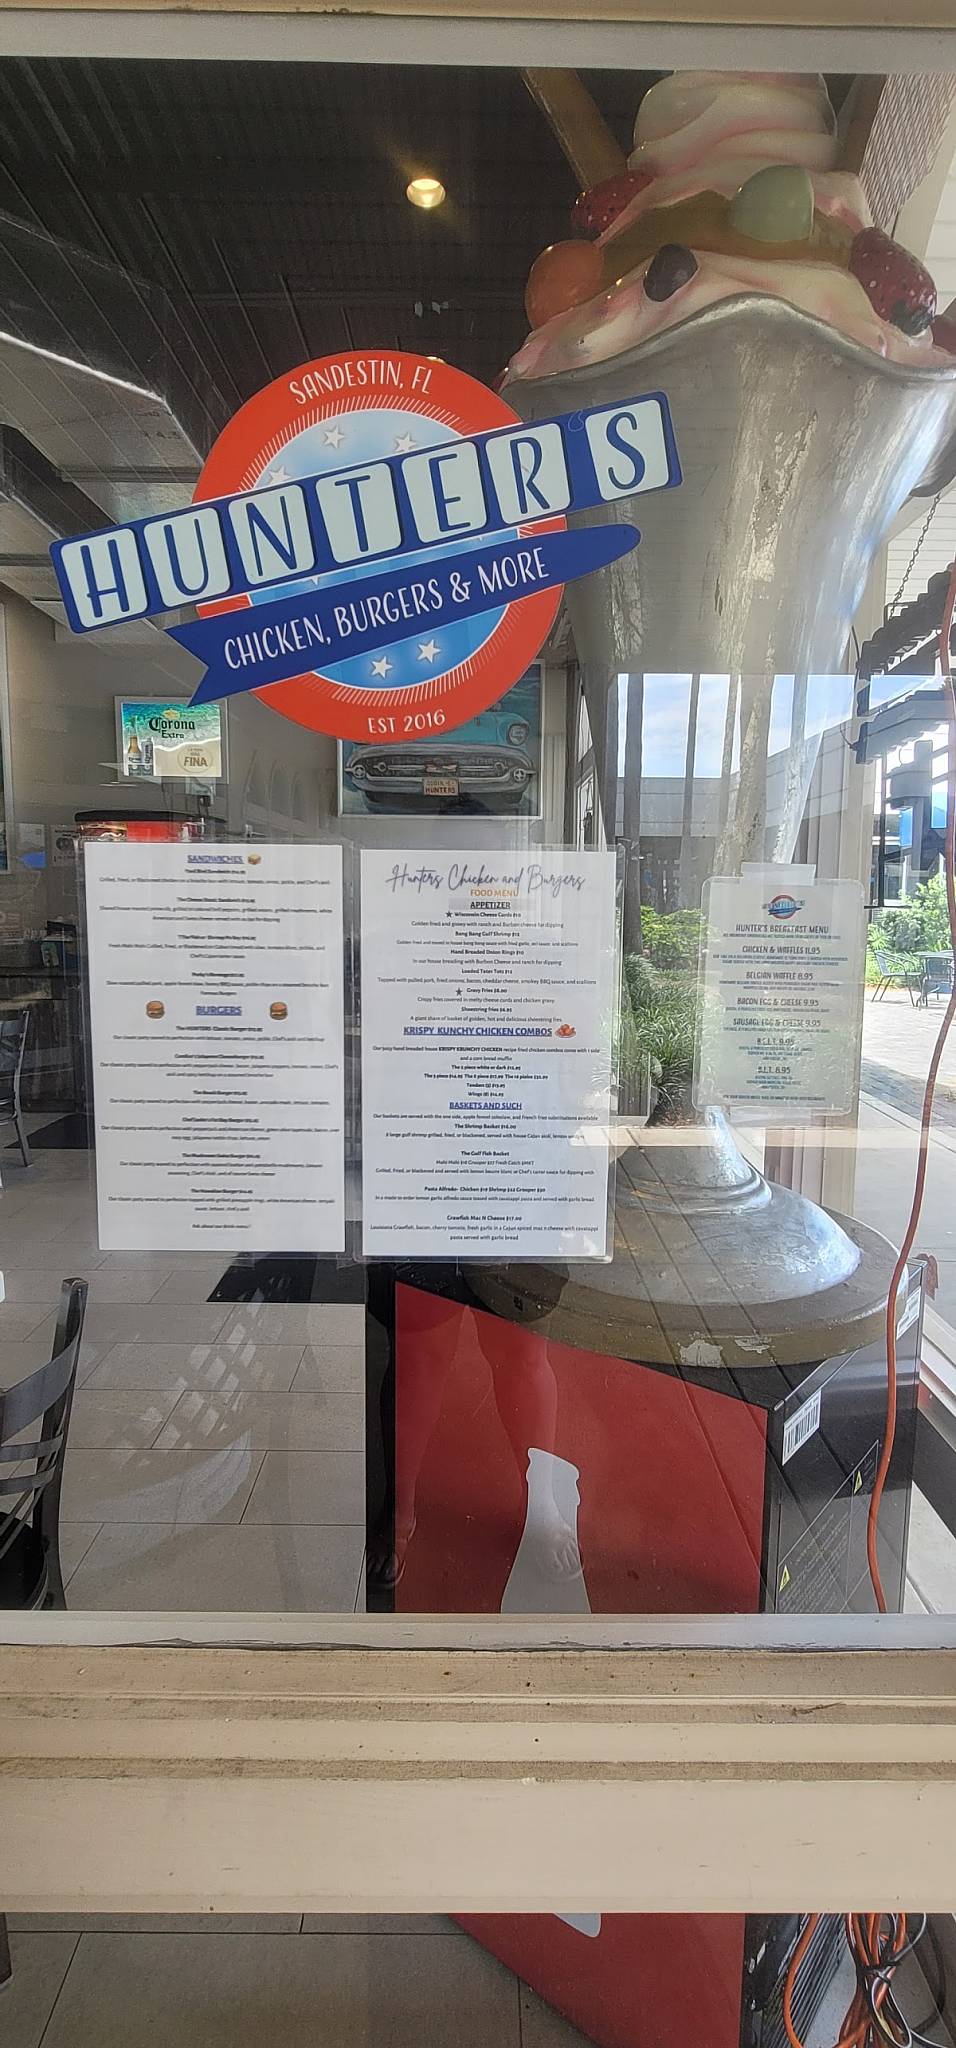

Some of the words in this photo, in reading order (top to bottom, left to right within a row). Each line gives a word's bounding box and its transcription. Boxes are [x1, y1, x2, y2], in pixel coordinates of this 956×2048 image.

[289, 360, 403, 404] SANDESTIN,
[411, 366, 432, 394] FL
[224, 617, 331, 669] CHICKEN,
[334, 579, 442, 637] BURGERS
[450, 572, 471, 602] &
[478, 547, 549, 594] MORE
[148, 717, 195, 733] Corona
[368, 717, 395, 734] EST
[404, 709, 446, 732] 2016
[161, 730, 184, 739] Extra
[183, 757, 209, 767] FINA
[187, 855, 243, 864] SANDWICHES
[385, 863, 443, 892] Hunters
[448, 863, 497, 890] Chicken
[502, 867, 523, 889] and
[527, 864, 585, 898] Burgers
[470, 889, 493, 897] FOOD
[494, 889, 519, 897] MENU
[470, 901, 511, 909] APPETIZER
[735, 924, 768, 933] HUNTER'S
[770, 925, 807, 933] BREAKFAST
[809, 926, 829, 934] MENU
[746, 971, 771, 979] BELGIAN
[773, 972, 796, 980] WAFFLE
[798, 972, 813, 980] 8.95
[803, 999, 819, 1007] 9.95
[196, 1006, 242, 1016] BURGERS
[733, 1018, 759, 1026] SAUSAGE
[805, 1019, 821, 1027] 9.95
[404, 1027, 434, 1035] KRISPY
[438, 1027, 474, 1036] KUNCHY
[476, 1028, 513, 1036] CHICKEN
[515, 1028, 552, 1036] COMBOS
[775, 1066, 790, 1074] 8.95
[450, 1102, 482, 1110] BASKETS
